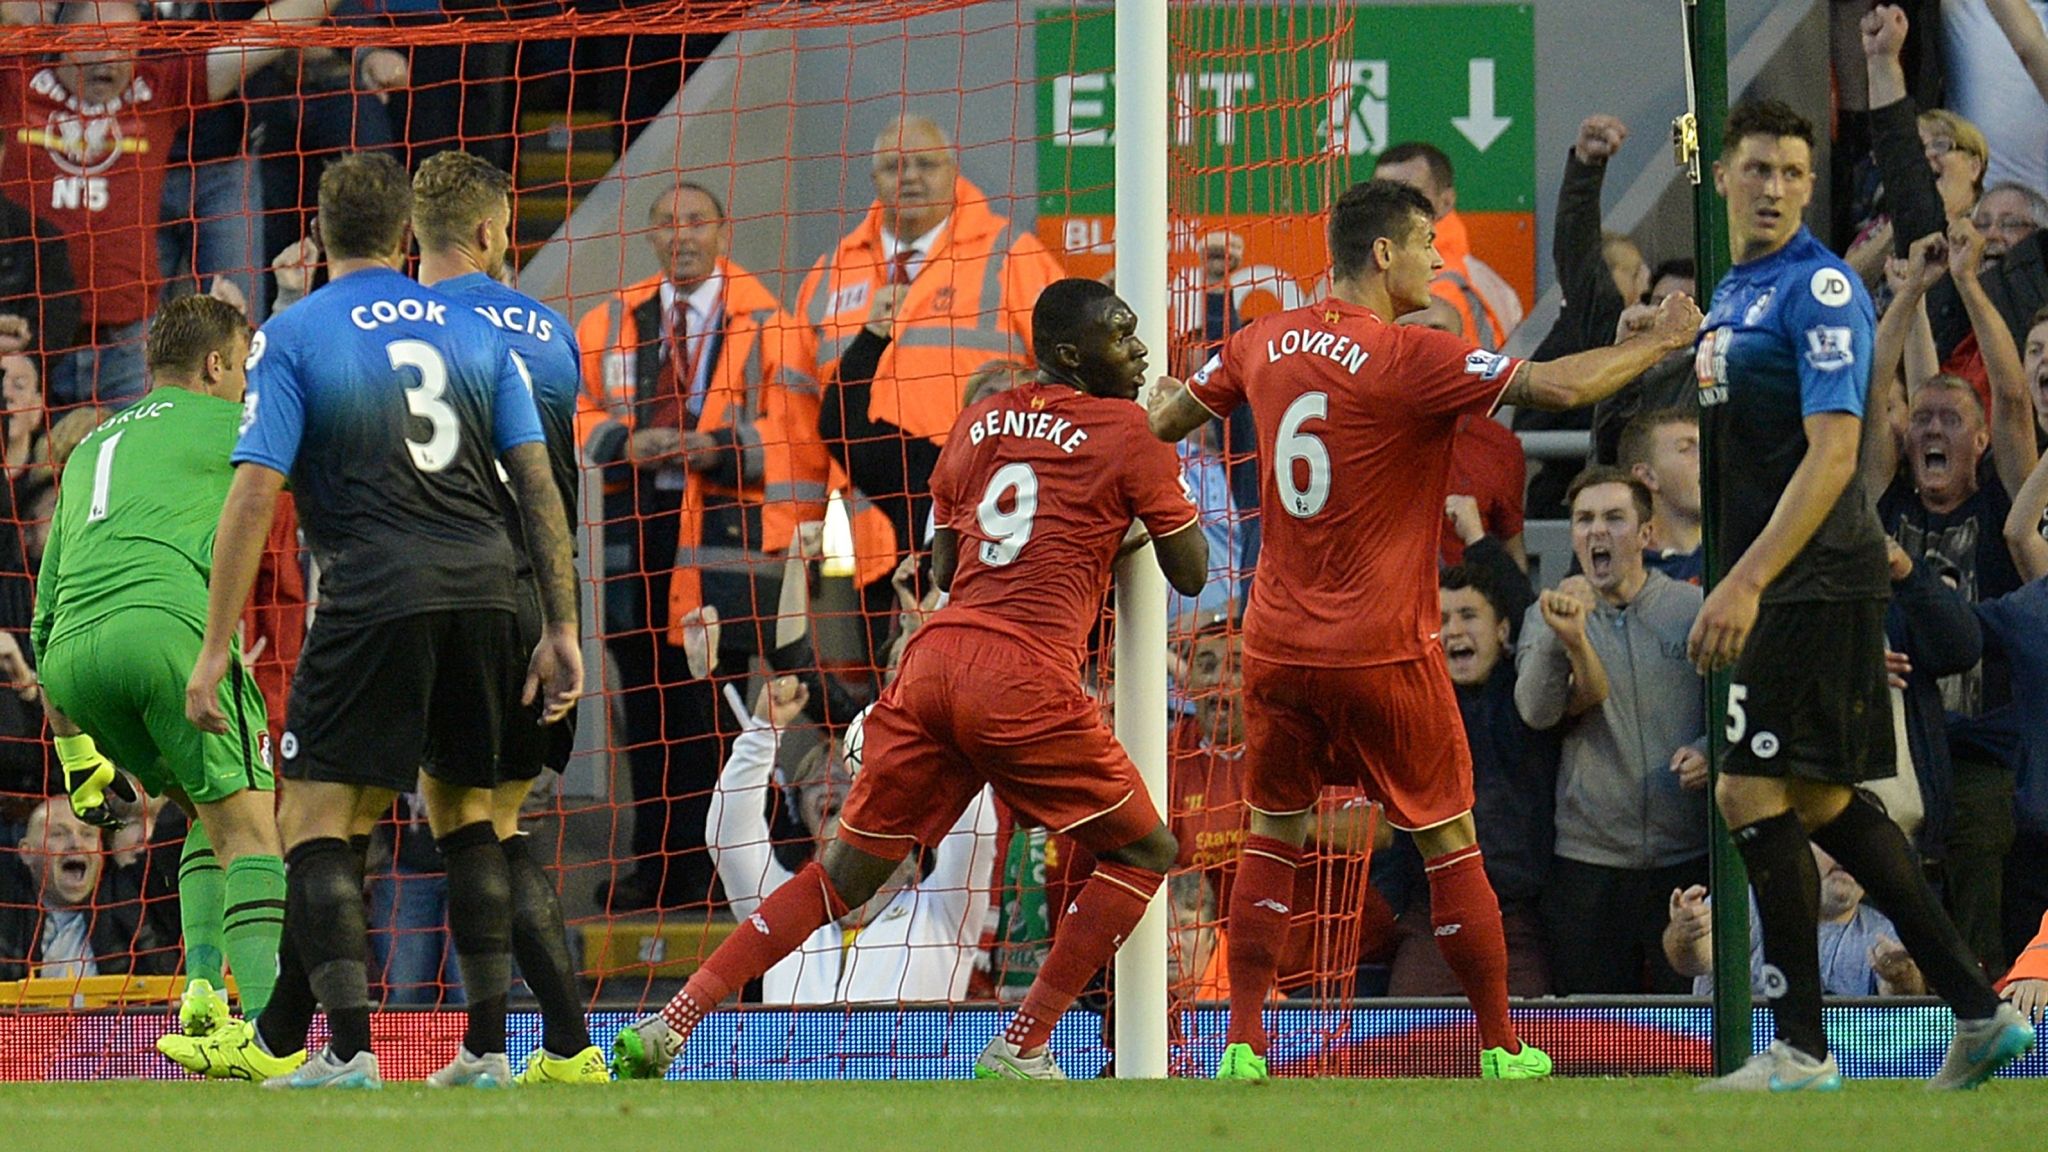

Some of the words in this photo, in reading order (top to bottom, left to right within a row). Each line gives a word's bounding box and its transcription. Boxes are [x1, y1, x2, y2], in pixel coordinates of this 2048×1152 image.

[1053, 73, 1255, 146] EIT
[351, 298, 447, 331] COOK
[1821, 278, 1845, 295] JD
[1267, 328, 1370, 376] LOVREN
[385, 338, 460, 473] 3
[969, 409, 1089, 455] BENTEKE
[87, 428, 126, 525] 1
[1274, 390, 1332, 519] 6
[976, 462, 1039, 568] 9
[1725, 683, 1748, 744] 5
